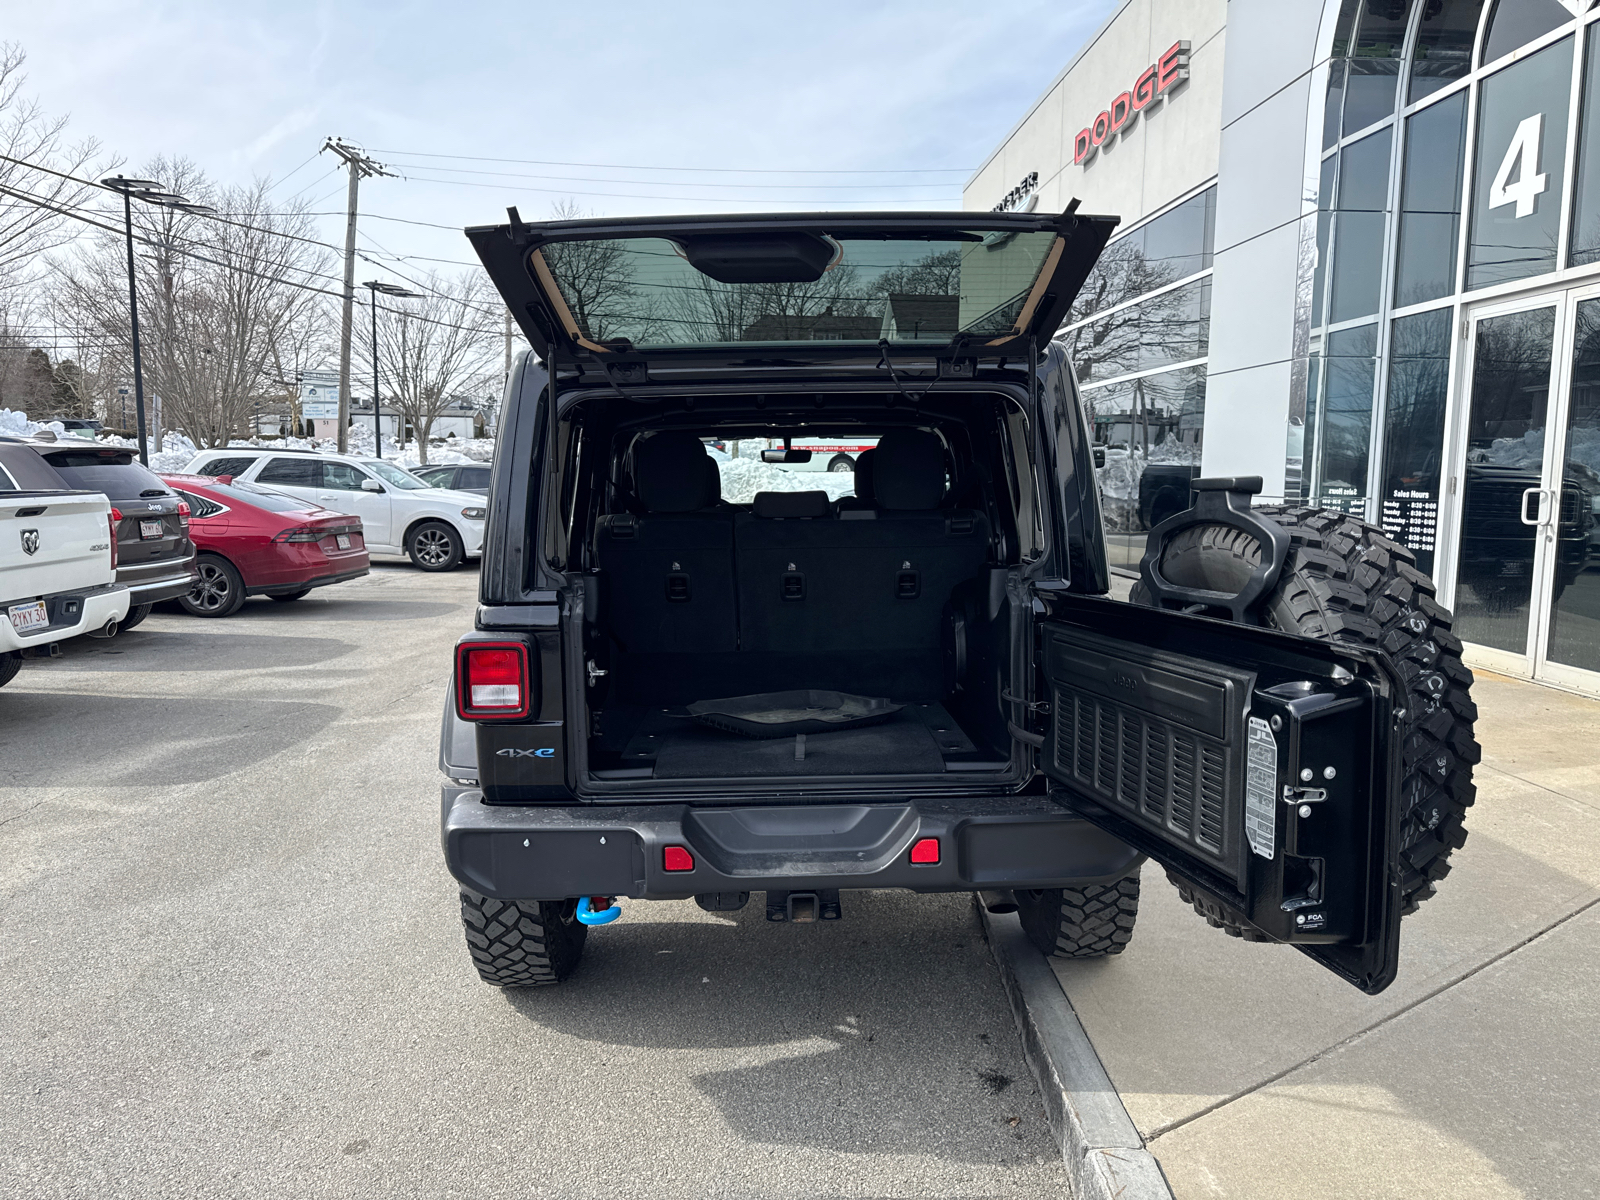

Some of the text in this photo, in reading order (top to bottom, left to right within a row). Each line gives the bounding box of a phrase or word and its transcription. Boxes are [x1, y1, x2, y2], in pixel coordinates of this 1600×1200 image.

[1074, 40, 1186, 165] DODGE
[1488, 112, 1547, 219] 4
[1393, 490, 1429, 499] Sales Hours
[148, 503, 162, 511] Jeep
[12, 611, 33, 627] 2YKY
[34, 608, 46, 622] 30
[1113, 672, 1138, 693] Jeep
